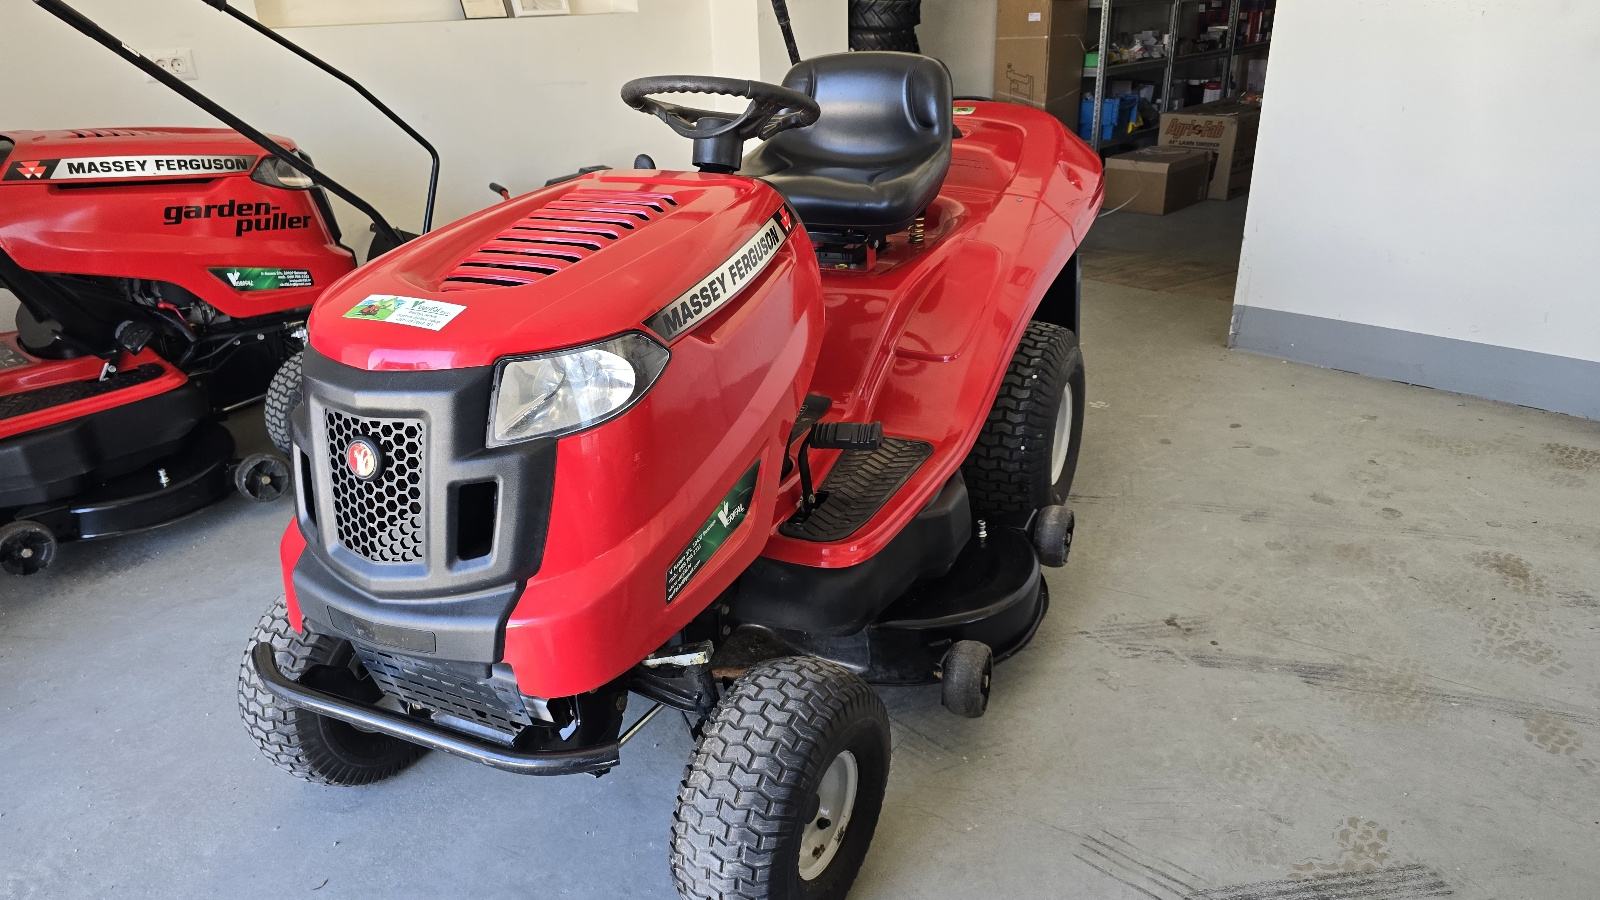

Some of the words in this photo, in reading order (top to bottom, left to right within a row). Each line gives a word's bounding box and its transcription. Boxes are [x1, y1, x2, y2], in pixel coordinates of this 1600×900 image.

[67, 159, 148, 175] MASSEY
[155, 157, 248, 172] FERGUSON
[163, 199, 280, 225] garden-
[235, 213, 312, 237] puller
[662, 272, 727, 336] MASSEY
[728, 224, 780, 286] FERGUSON
